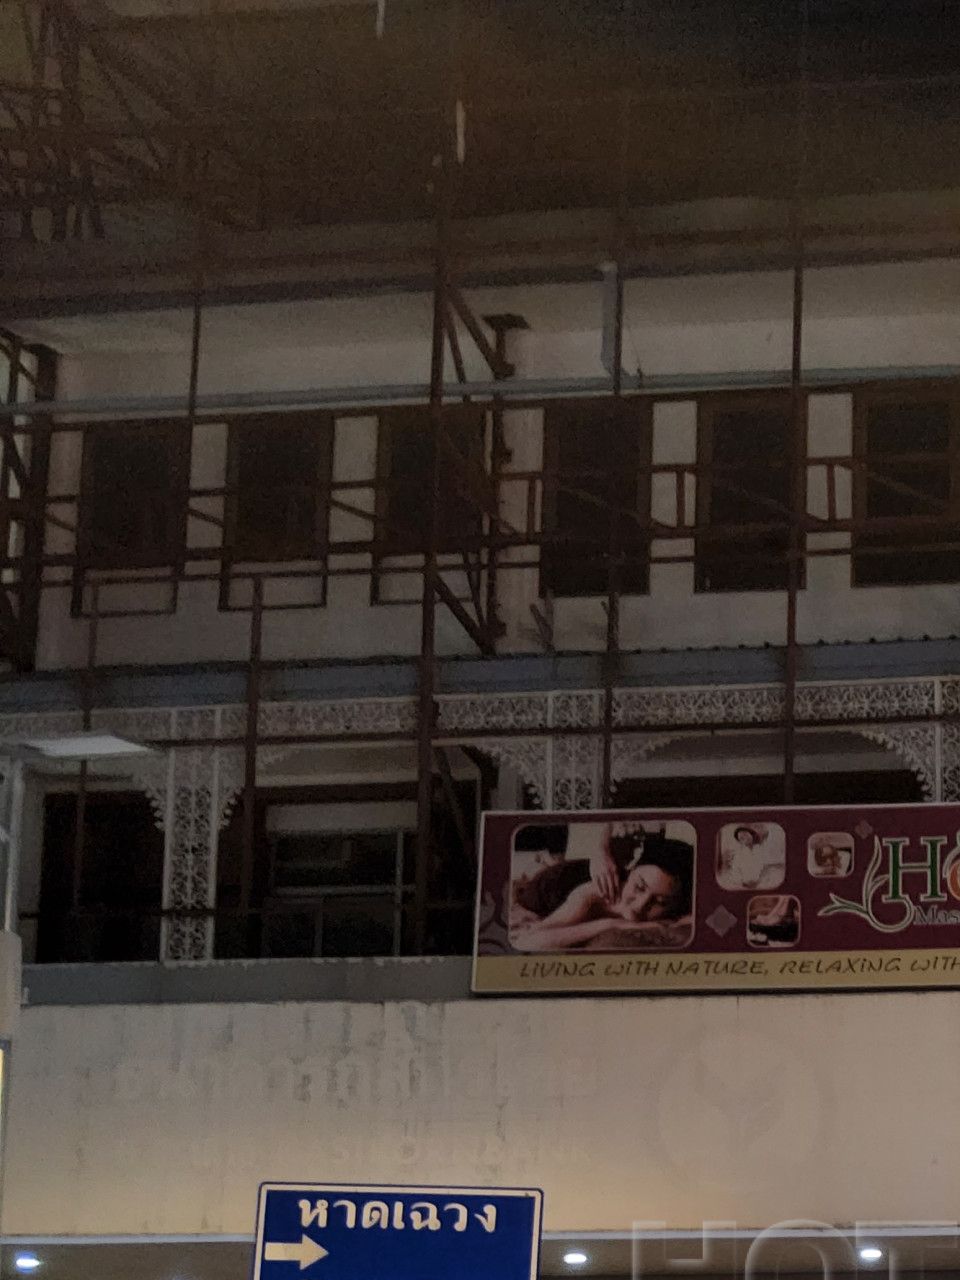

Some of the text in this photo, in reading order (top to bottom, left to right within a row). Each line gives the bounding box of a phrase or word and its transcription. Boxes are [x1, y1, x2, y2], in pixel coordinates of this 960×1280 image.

[665, 959, 769, 976] NATURE,
[297, 1198, 498, 1233] หาดเฉวง
